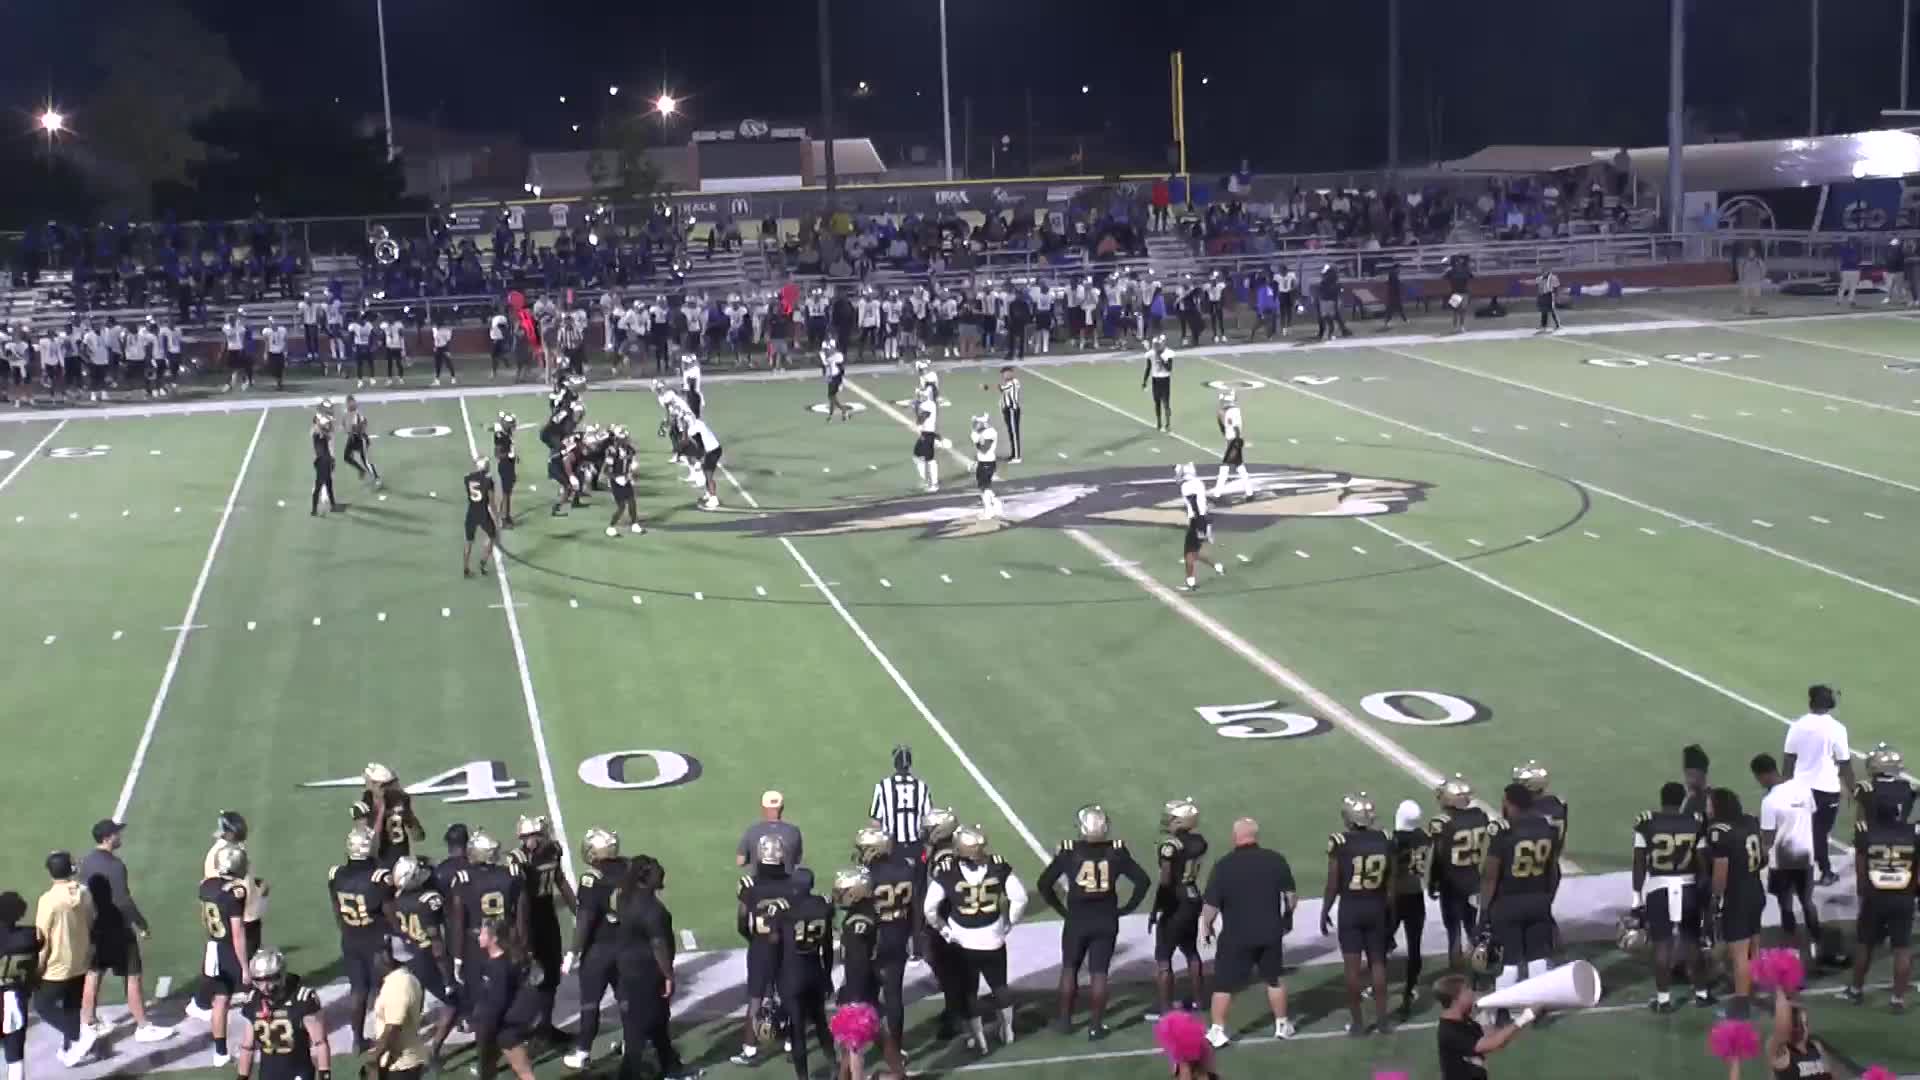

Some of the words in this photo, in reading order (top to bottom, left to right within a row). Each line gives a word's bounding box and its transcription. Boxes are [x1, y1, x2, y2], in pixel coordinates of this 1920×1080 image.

[468, 480, 482, 502] 5
[1511, 838, 1552, 878] 69
[1652, 833, 1696, 870] 27
[1075, 860, 1109, 892] 41
[337, 891, 369, 926] 51
[955, 878, 1000, 915] 35
[255, 1019, 294, 1054] 33
